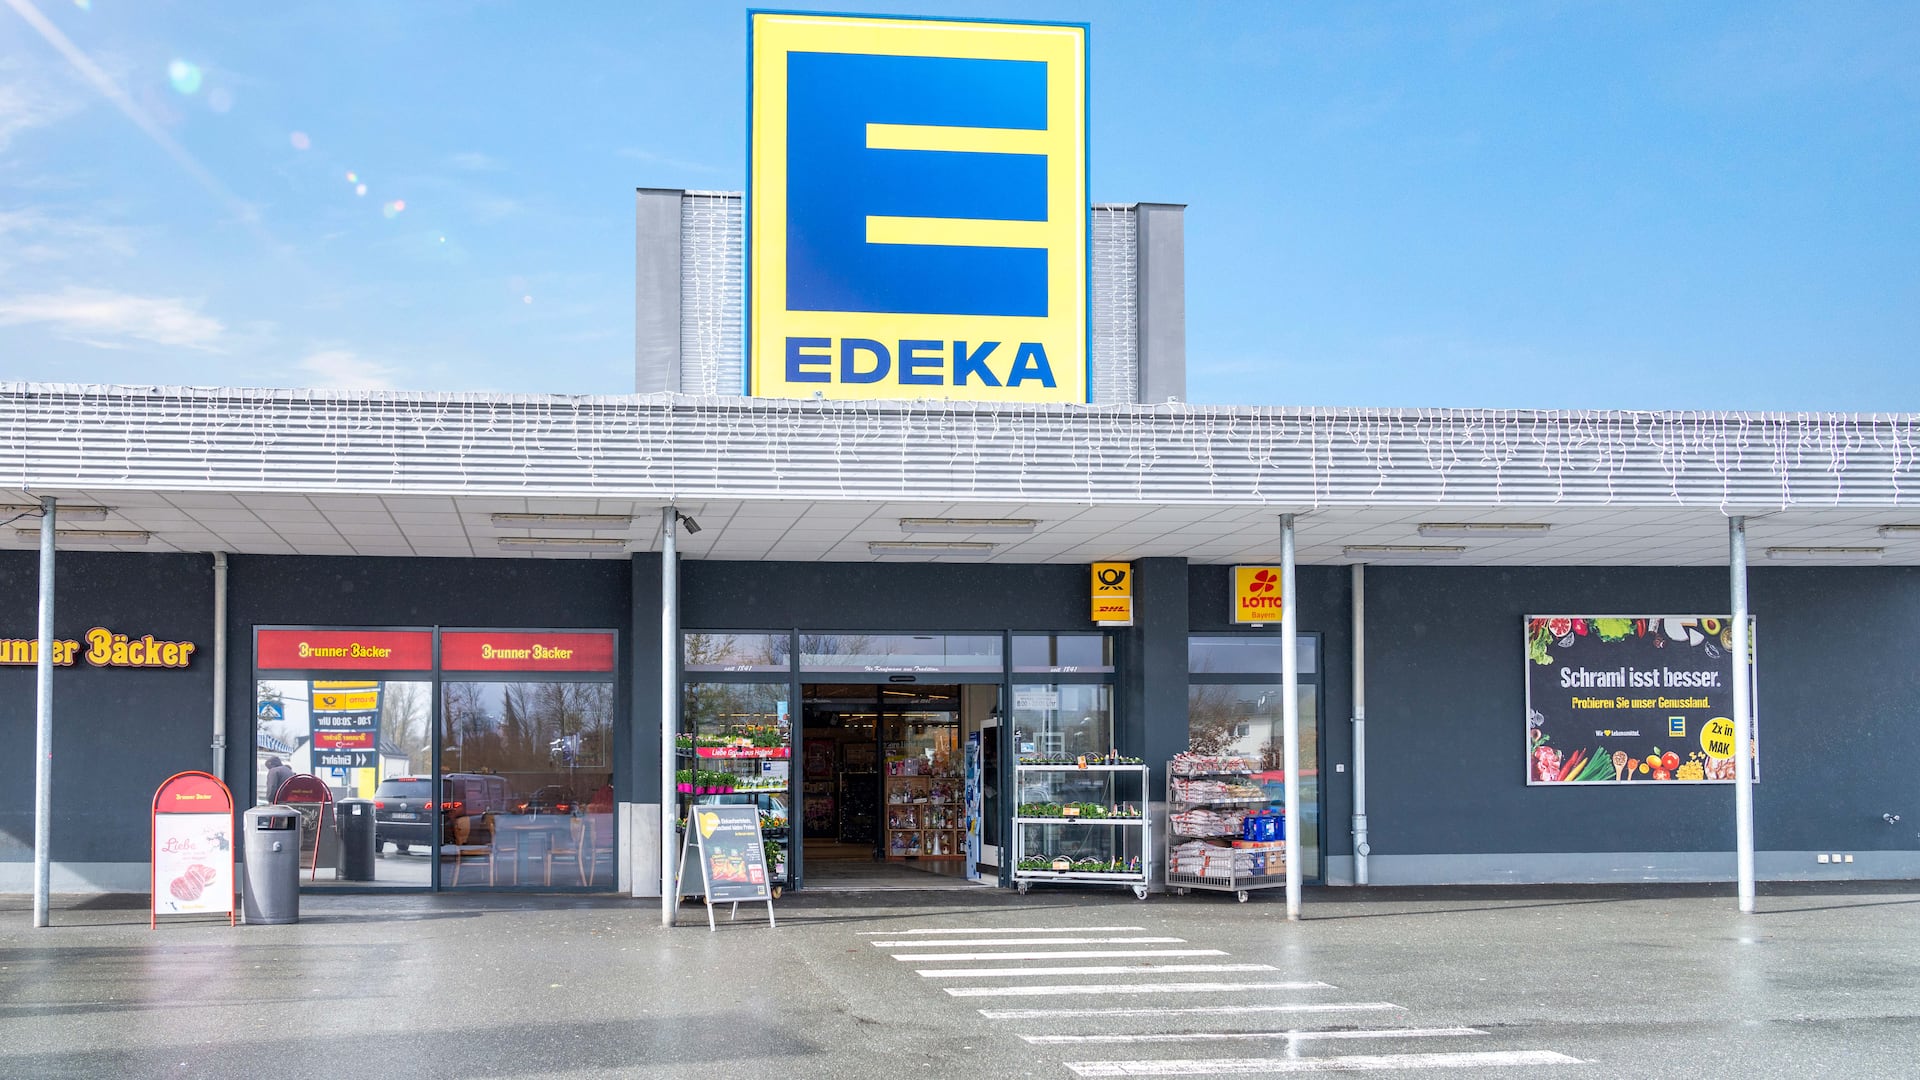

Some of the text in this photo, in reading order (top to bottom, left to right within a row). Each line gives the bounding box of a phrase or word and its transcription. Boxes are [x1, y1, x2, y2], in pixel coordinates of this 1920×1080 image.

[786, 50, 1049, 317] E
[785, 336, 1057, 388] EDEKA
[1242, 596, 1282, 608] LOTTO
[1251, 612, 1276, 620] Bayern
[86, 627, 195, 667] Bäcker
[299, 642, 392, 658] Brunner Bäcker
[481, 643, 574, 659] Brunner Bäcker
[1560, 667, 1721, 688] Schraml isst besser.
[1571, 697, 1711, 709] Probieren Sie unser Genussland.
[1712, 722, 1733, 736] 2x in
[712, 748, 727, 756] Liebe
[1708, 740, 1731, 755] MAK
[161, 837, 197, 854] Liebe
